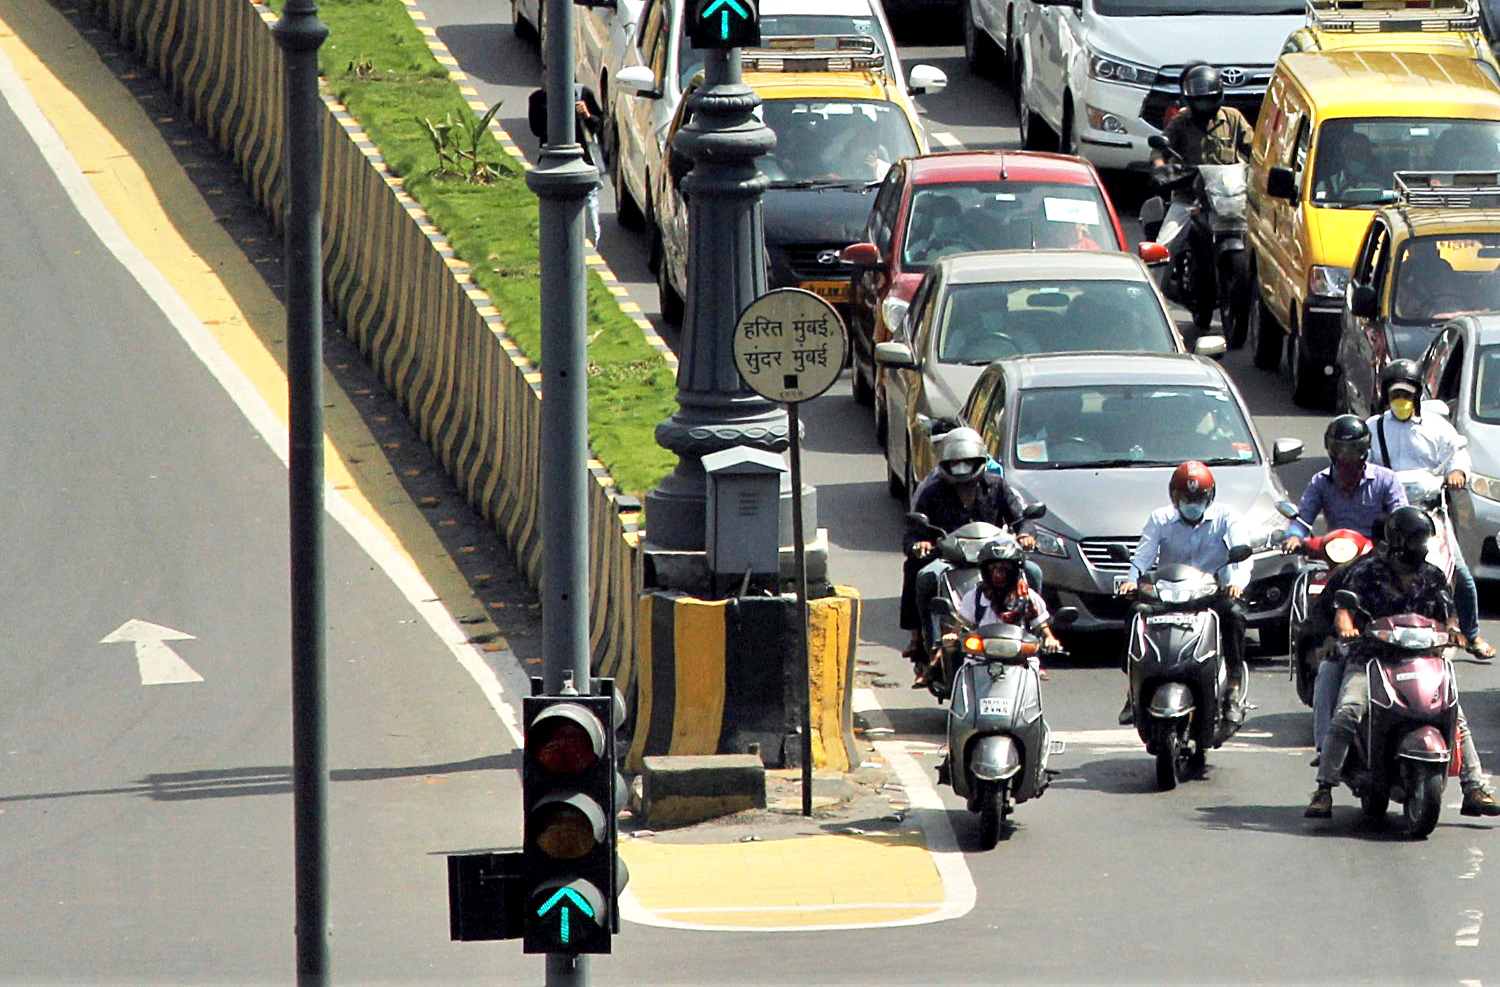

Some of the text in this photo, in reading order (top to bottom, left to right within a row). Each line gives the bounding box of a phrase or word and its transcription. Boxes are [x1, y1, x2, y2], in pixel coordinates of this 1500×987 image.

[743, 316, 783, 340] हरित
[743, 343, 828, 374] सुंदर मुंबई
